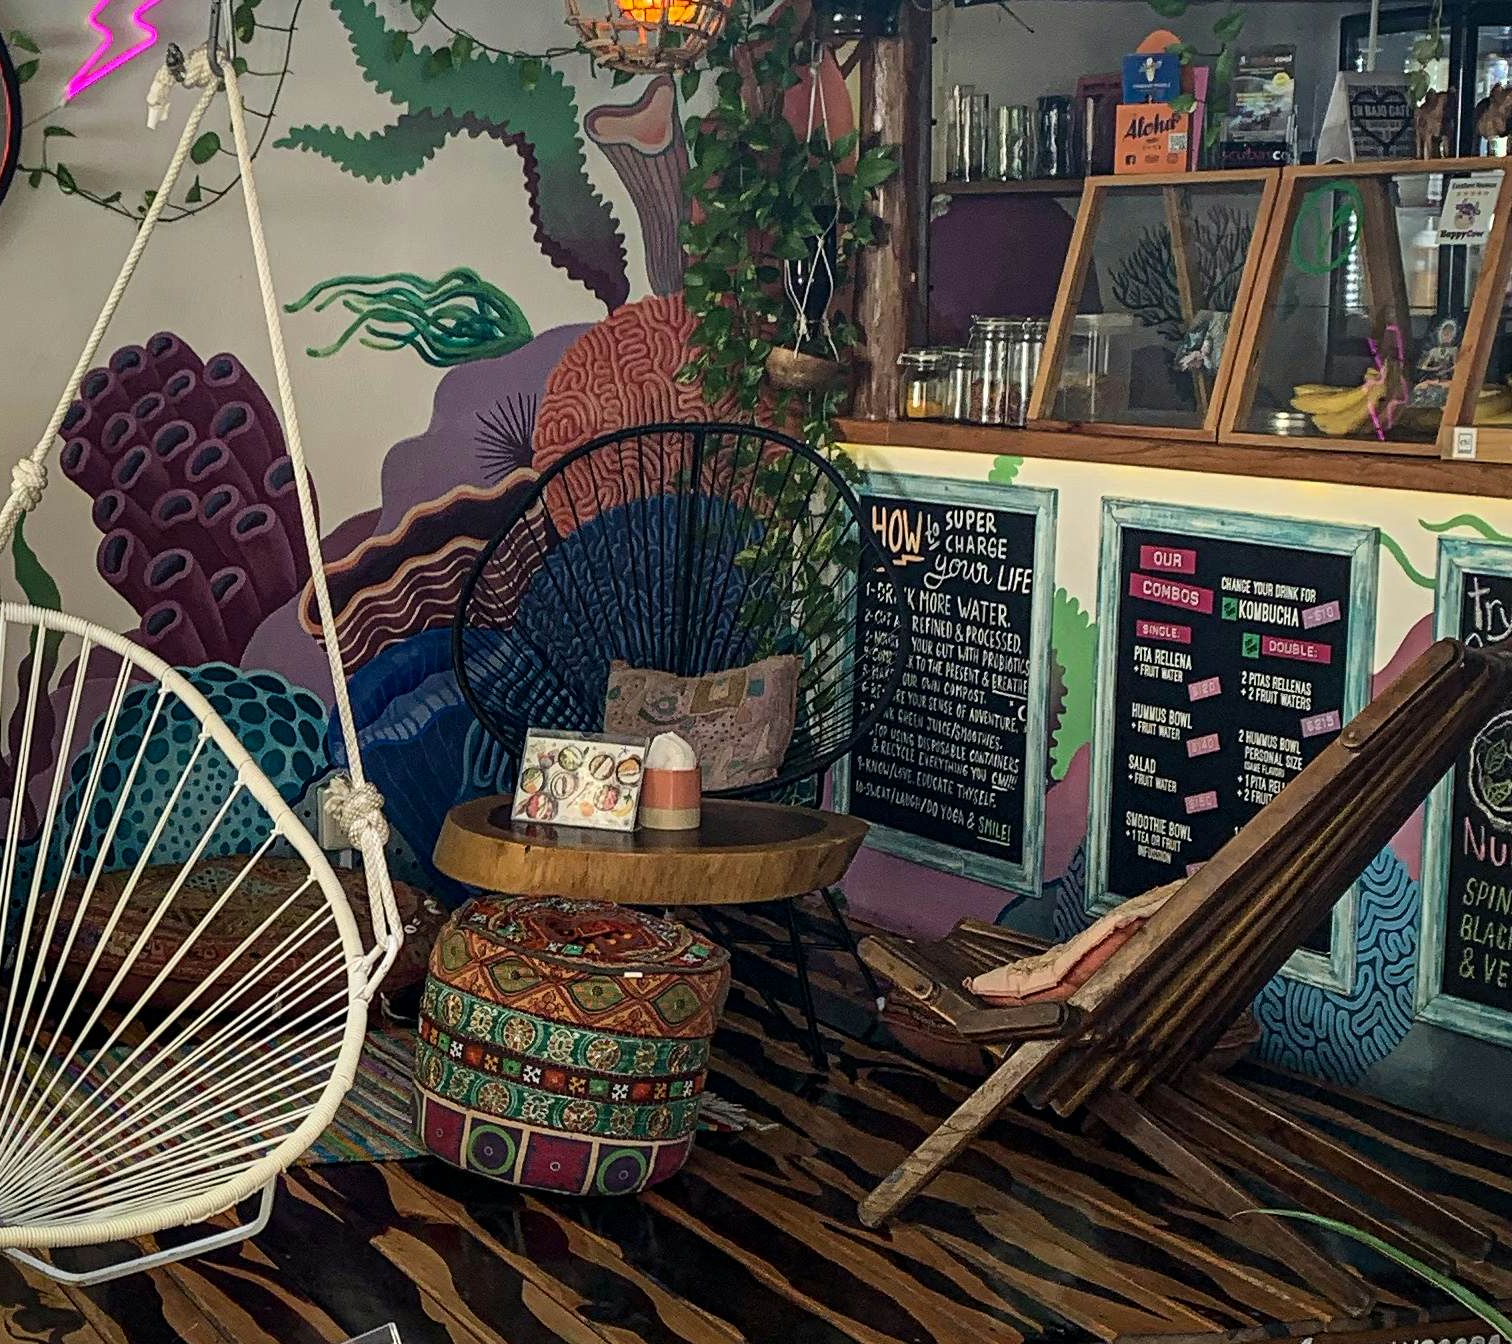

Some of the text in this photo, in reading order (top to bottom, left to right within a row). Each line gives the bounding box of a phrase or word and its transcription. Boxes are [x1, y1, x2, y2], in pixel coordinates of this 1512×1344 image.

[945, 509, 997, 534] SUPER
[945, 534, 1008, 560] CHARGE
[1153, 550, 1182, 567] OUR
[923, 553, 1033, 594] your LIFE
[1142, 580, 1200, 606] COMBOS
[1221, 576, 1316, 604] CHANGE YOUR DRINK FOR
[919, 589, 1011, 629] MORE WATER.
[1238, 599, 1300, 628] KOMBUCHA
[912, 614, 953, 640] REFINED
[912, 636, 934, 655] YOUR
[936, 642, 955, 659] GUT
[958, 644, 979, 663] WITH
[982, 649, 1031, 676] PROBIOTICS
[1134, 645, 1192, 671] PITA RELLENA
[1268, 640, 1318, 657] DOUBLE:
[945, 661, 979, 685] PRESENT
[1140, 663, 1183, 683] FRUIT WATER
[1248, 672, 1271, 690] PITAS
[1271, 676, 1312, 696] RELLENAS
[1255, 688, 1278, 705] FRUIT
[1280, 692, 1312, 712] WATERS
[1131, 701, 1193, 730] HUMMUS BOWL
[1137, 720, 1180, 741] FRUIT WATER
[1245, 730, 1278, 749] HUMMUS
[1279, 737, 1301, 755] BOWL
[1128, 754, 1157, 775] SALAD
[1244, 746, 1303, 771] PERSONAL SIZE
[916, 771, 954, 795] EDUCATE
[970, 766, 987, 783] YOU
[1134, 772, 1177, 793] FRUIT WATER
[1250, 776, 1267, 792] PITA
[941, 807, 965, 826] YOGA
[978, 816, 1012, 842] SMILE!
[1126, 811, 1193, 842] SMOOTHIE BOWL
[1137, 831, 1150, 846] TEA
[1161, 835, 1181, 853] FRUIT
[1463, 877, 1512, 916] SPIN
[1460, 913, 1512, 950] BLAC
[1459, 947, 1476, 979] &
